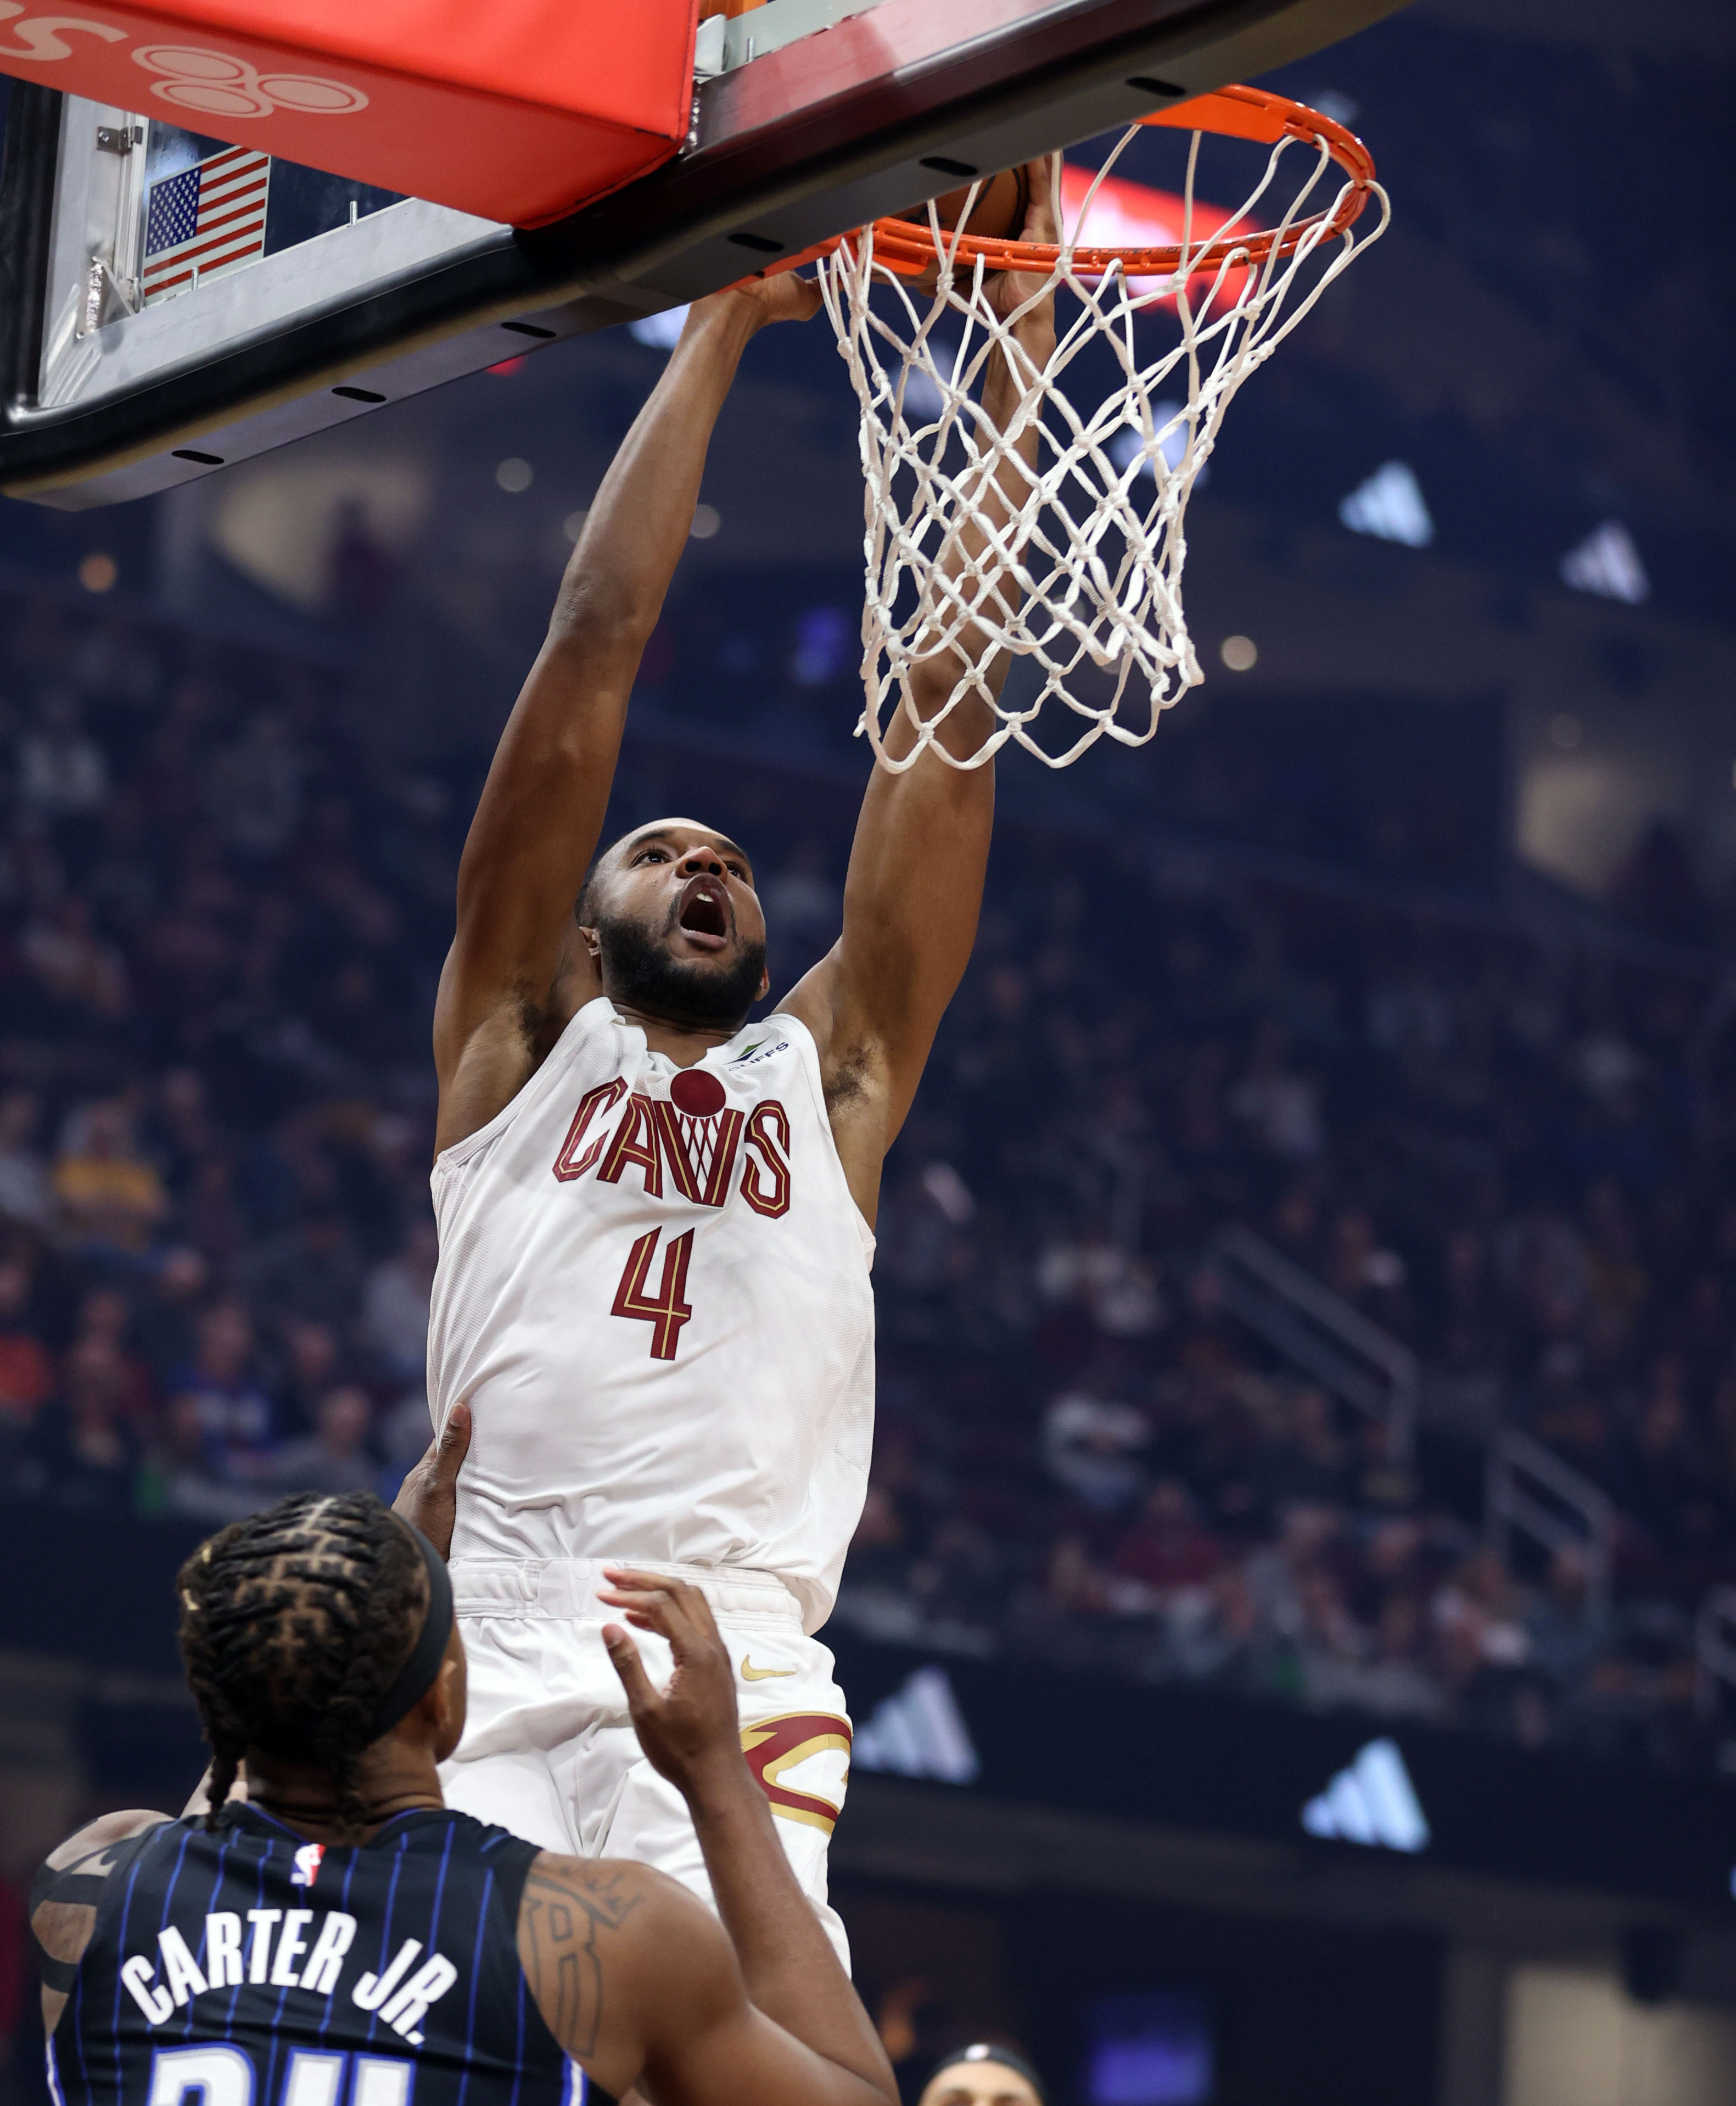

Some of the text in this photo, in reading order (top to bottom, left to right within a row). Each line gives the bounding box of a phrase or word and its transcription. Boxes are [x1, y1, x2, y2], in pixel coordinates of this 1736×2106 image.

[729, 1042, 789, 1071] CLIFFS
[552, 1075, 790, 1219] CAVS
[610, 1226, 695, 1360] 4
[120, 1909, 457, 2045] CARTER JR.
